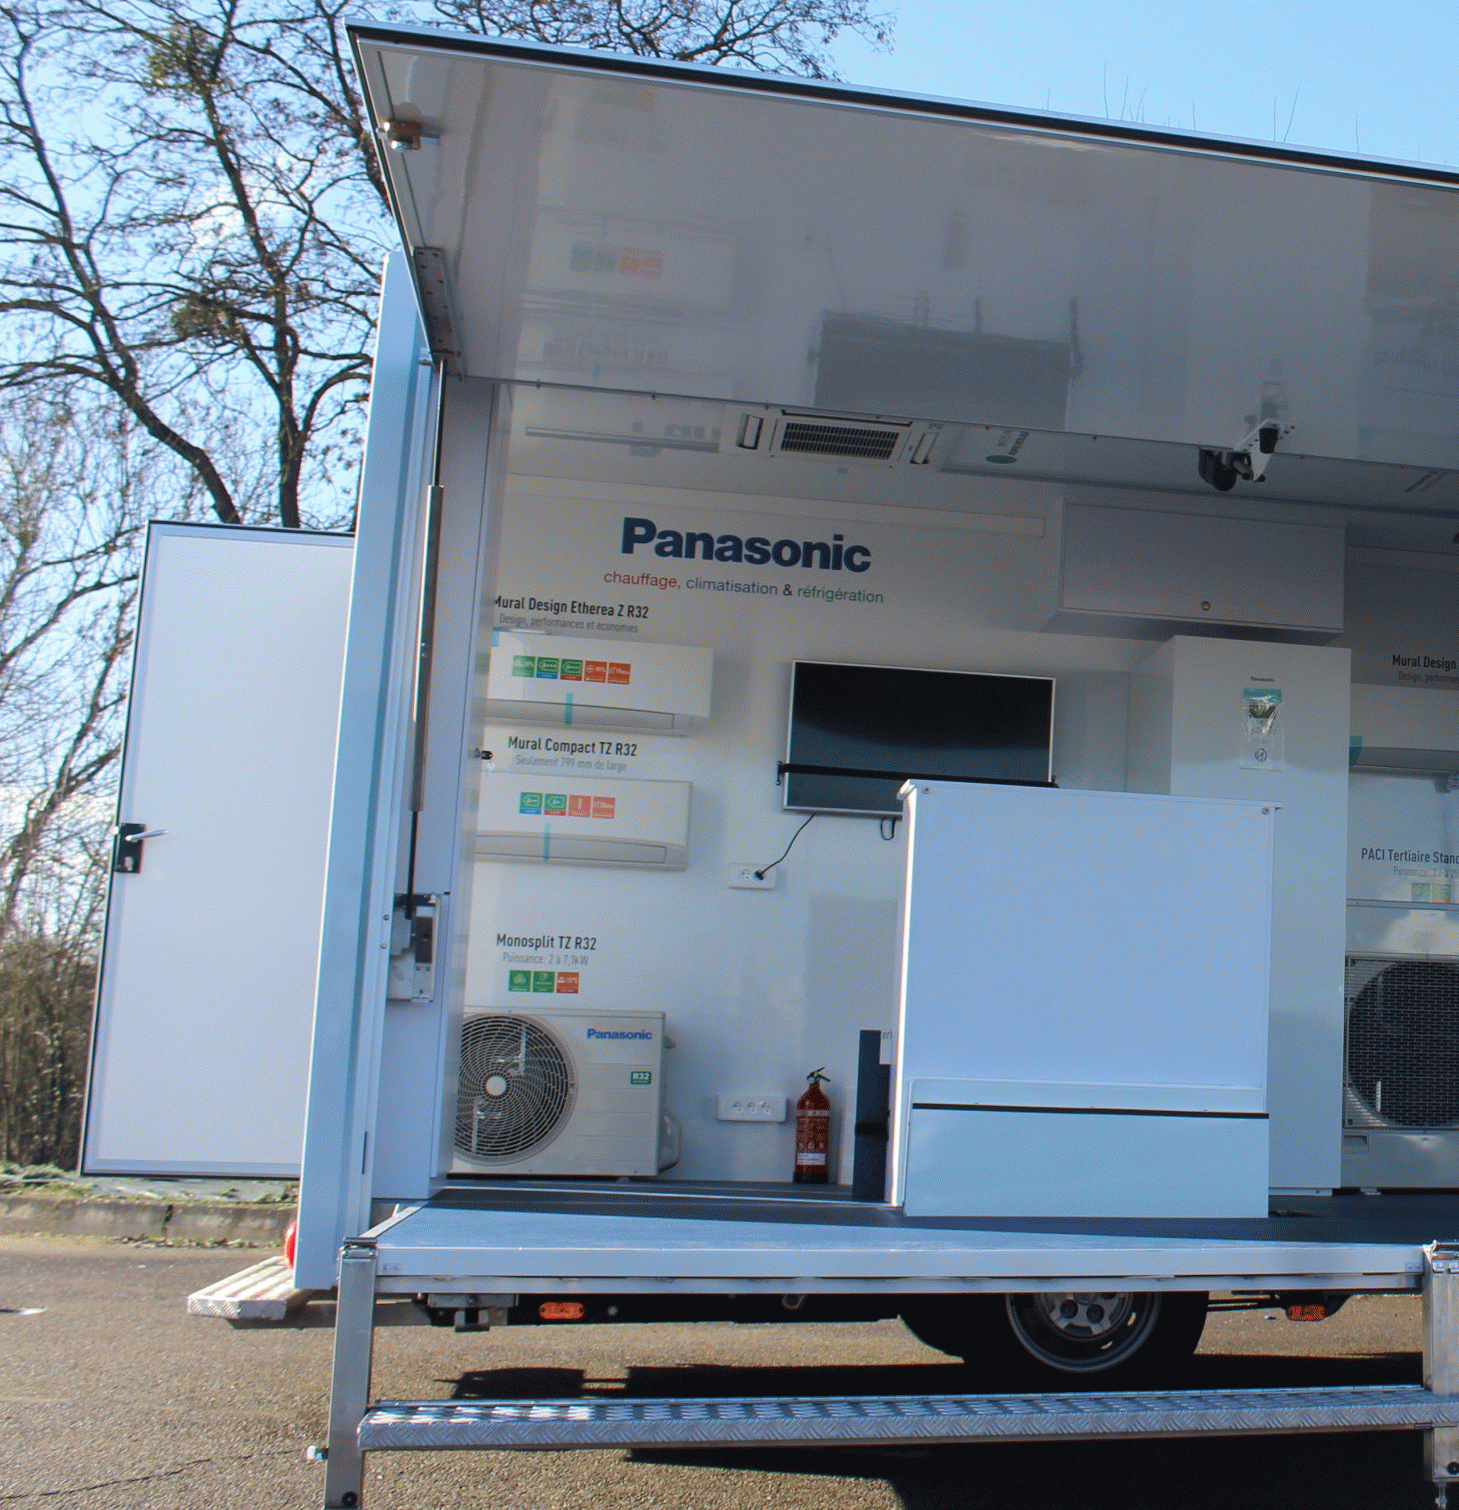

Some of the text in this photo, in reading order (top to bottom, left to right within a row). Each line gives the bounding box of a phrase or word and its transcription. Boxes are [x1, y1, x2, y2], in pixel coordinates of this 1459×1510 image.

[621, 517, 872, 573] Panasonic
[603, 571, 885, 604] chauffage, climatisation & réfrigération
[529, 597, 568, 615] Design
[571, 600, 615, 616] Etherea
[618, 604, 624, 617] Z
[627, 605, 649, 619] R32
[1392, 654, 1420, 668] Mural
[1423, 655, 1456, 672] Design
[508, 736, 638, 757] Mural Compact TZ R32
[1361, 848, 1385, 861] PACI
[1388, 849, 1430, 863] Tertiaire
[496, 933, 597, 951] Monosplit TZ R32
[587, 1028, 653, 1041] Panasonic
[632, 1072, 649, 1080] R32
